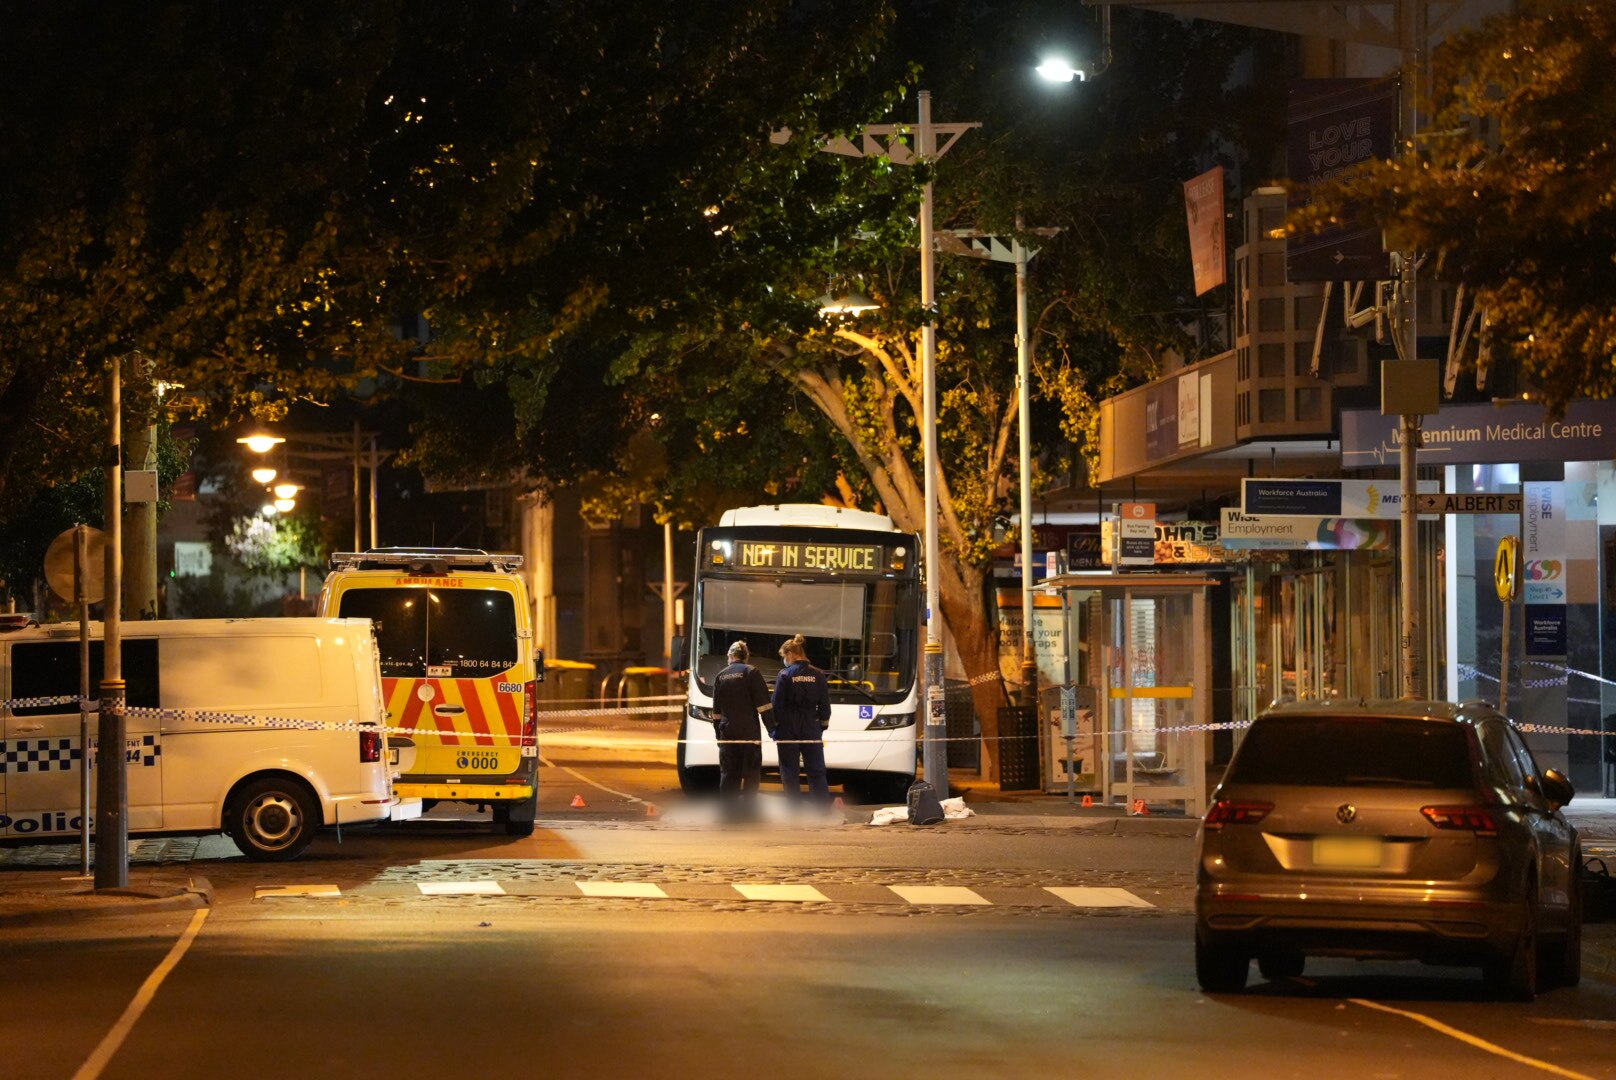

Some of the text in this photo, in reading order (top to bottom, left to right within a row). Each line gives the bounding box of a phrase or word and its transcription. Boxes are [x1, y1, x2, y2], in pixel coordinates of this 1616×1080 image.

[1309, 116, 1371, 150] LOVE
[1308, 138, 1373, 170] YOUR
[1392, 421, 1602, 444] Mennium Medical Centre
[1258, 489, 1328, 497] Workforce Australia
[1382, 495, 1401, 504] ME
[1445, 496, 1522, 511] ALBERT ST
[1541, 487, 1553, 520] WISE
[1527, 487, 1539, 553] Employment
[1228, 523, 1293, 536] Employment
[742, 544, 874, 570] NOT IN SERVICE
[1174, 546, 1186, 559] &
[1038, 630, 1062, 639] your
[999, 638, 1018, 647] ood
[460, 660, 477, 668] 1800
[491, 660, 501, 668] 84
[502, 660, 512, 668] 84
[719, 672, 743, 681] FORENSIC
[792, 675, 816, 683] FORENSIC
[499, 683, 522, 692] 6680
[471, 757, 498, 770] 000
[0, 812, 94, 833] Polic
